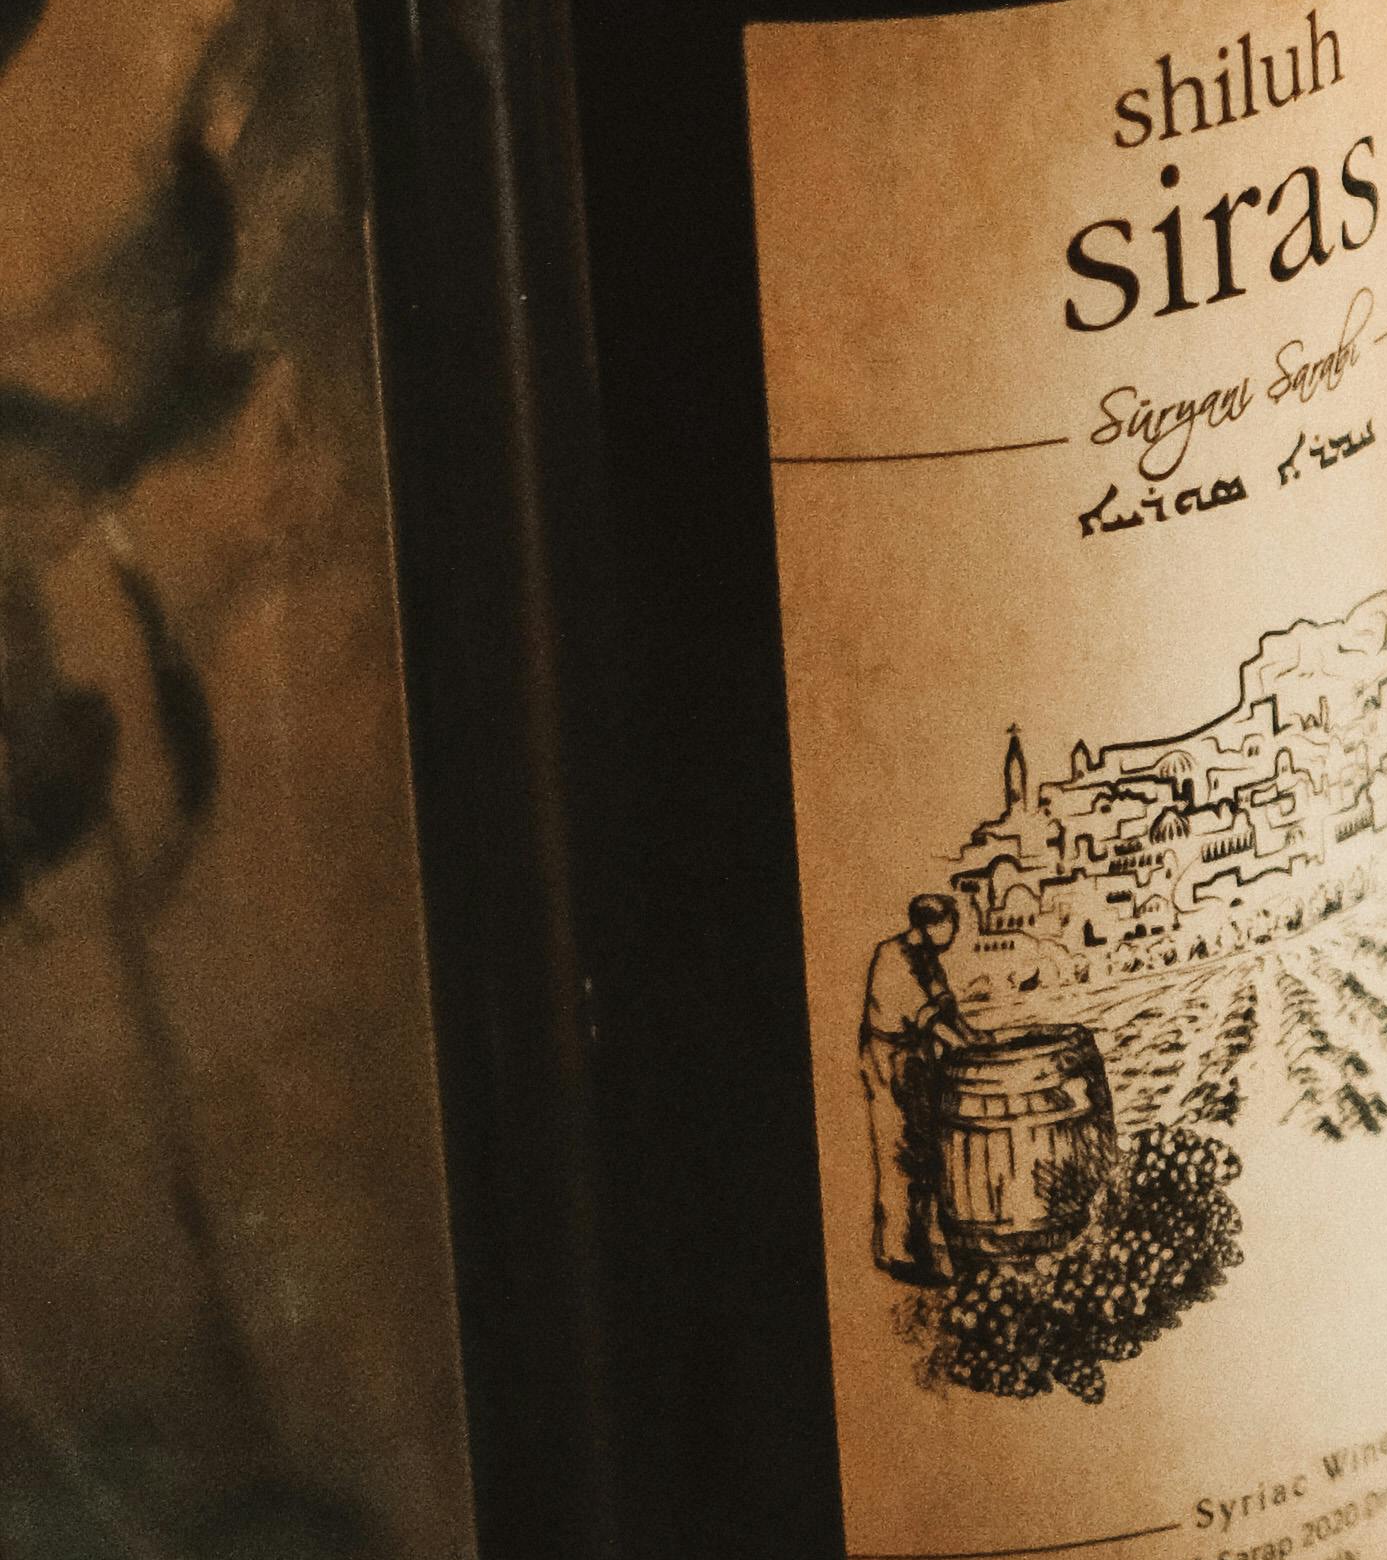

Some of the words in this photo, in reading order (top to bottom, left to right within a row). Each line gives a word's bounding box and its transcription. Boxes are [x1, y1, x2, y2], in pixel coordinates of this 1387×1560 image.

[1113, 8, 1345, 148] shiluh
[1065, 135, 1379, 332] siras
[1195, 1474, 1307, 1533] Syriac
